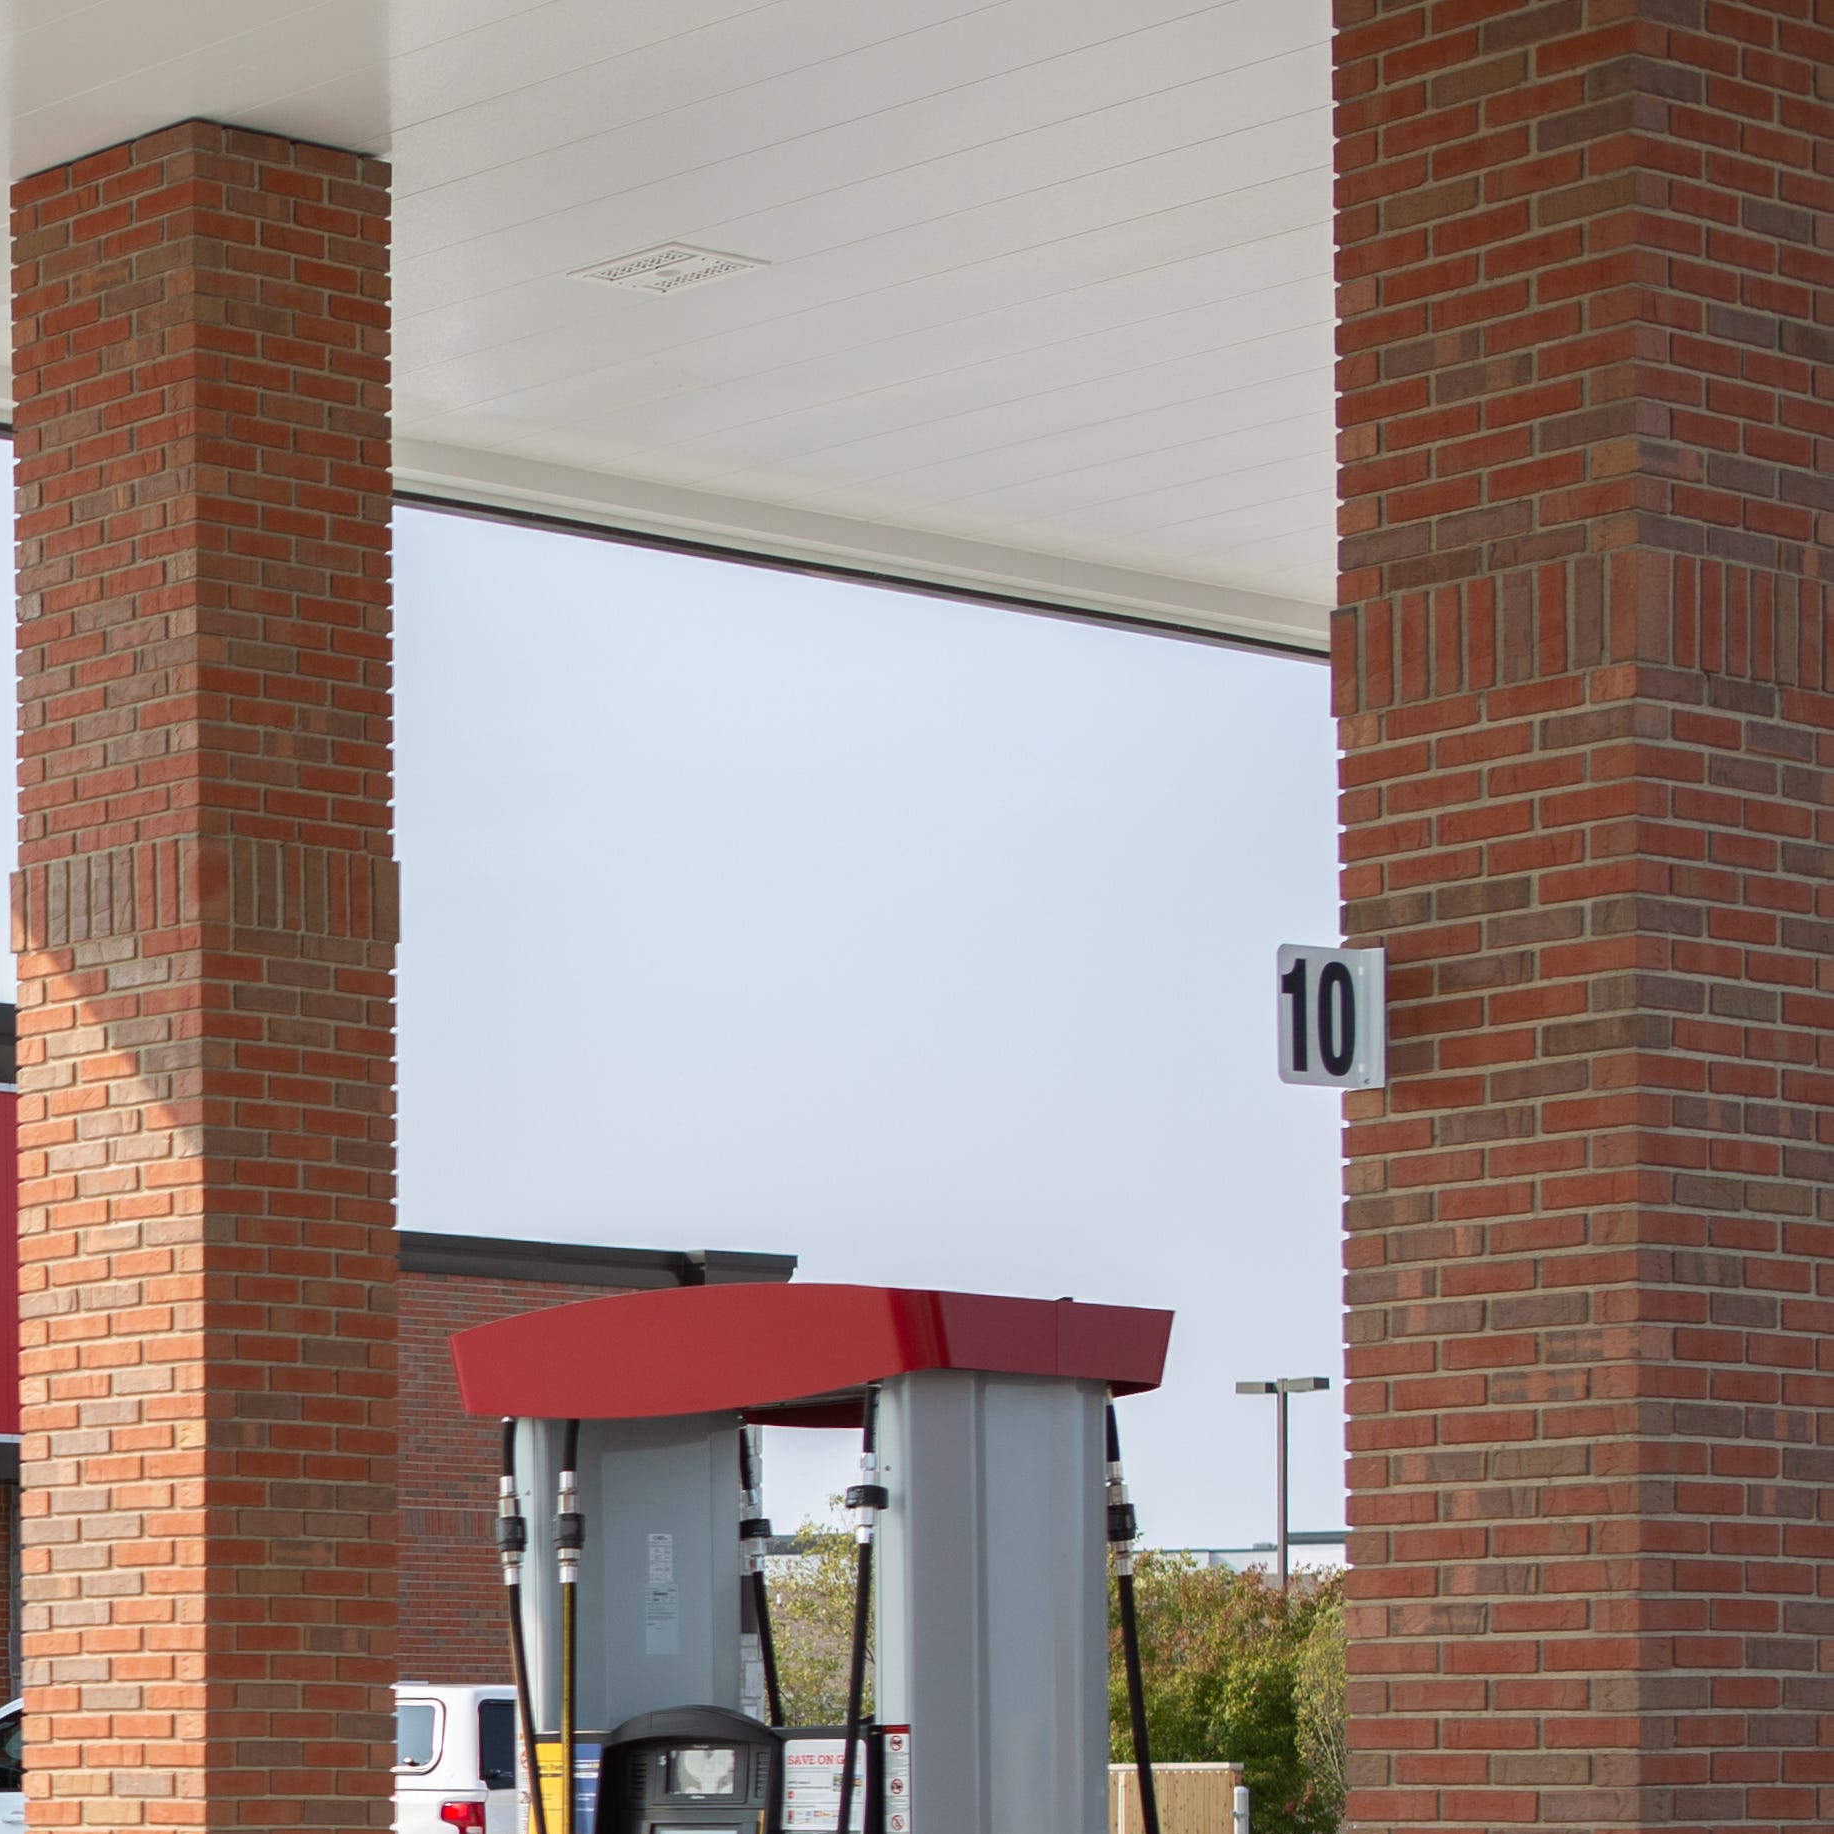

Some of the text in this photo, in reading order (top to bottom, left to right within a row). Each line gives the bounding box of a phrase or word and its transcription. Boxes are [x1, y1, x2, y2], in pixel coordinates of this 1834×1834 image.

[1281, 958, 1356, 1077] 10
[786, 1754, 815, 1765] SAVE
[817, 1754, 833, 1765] ON
